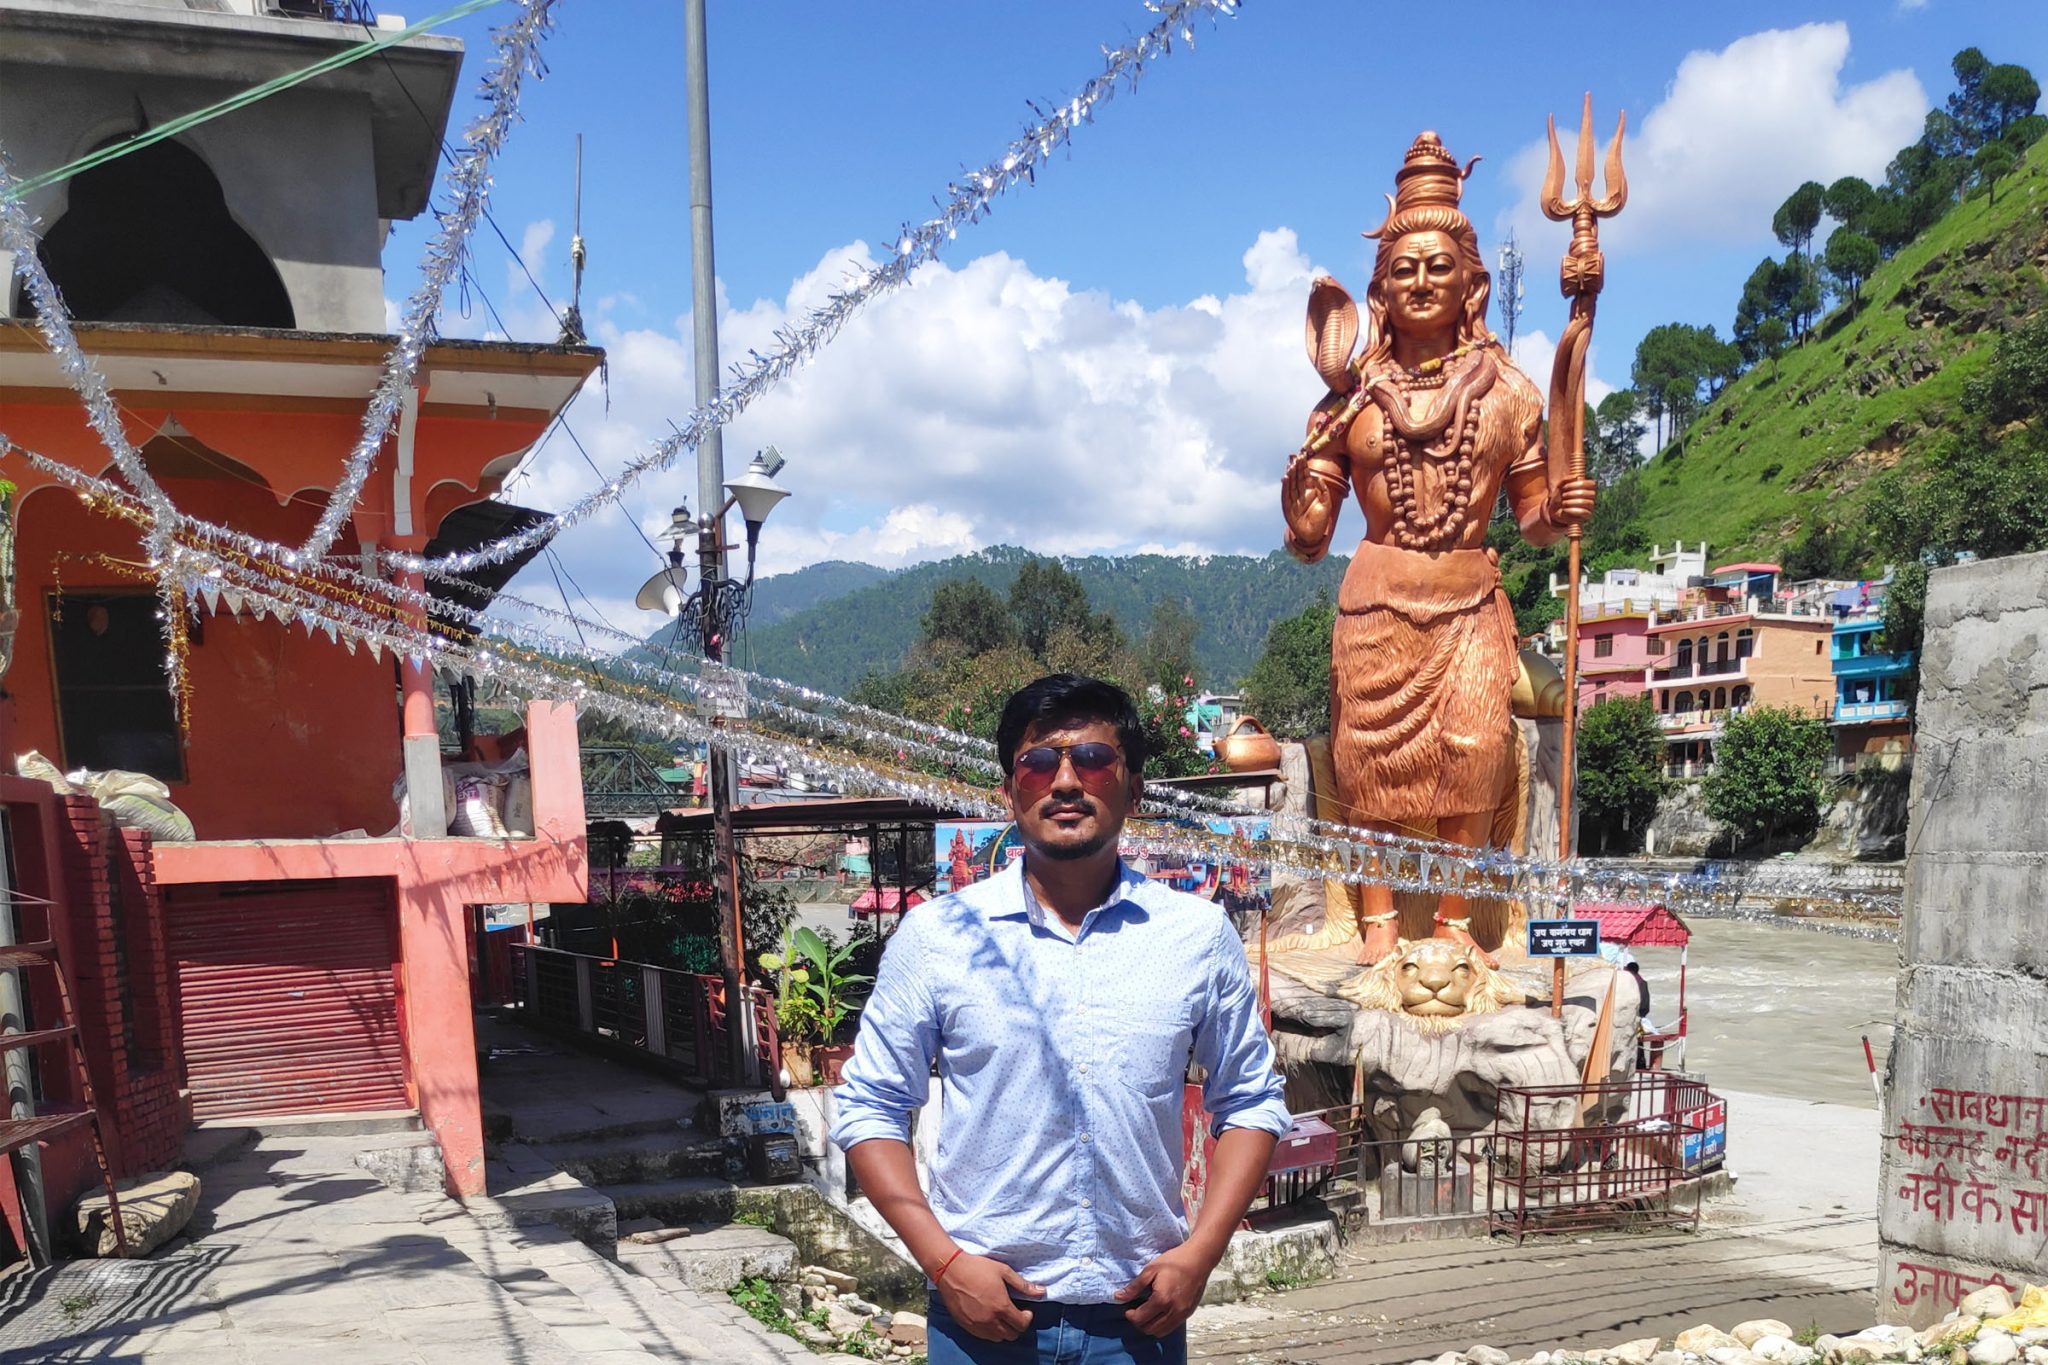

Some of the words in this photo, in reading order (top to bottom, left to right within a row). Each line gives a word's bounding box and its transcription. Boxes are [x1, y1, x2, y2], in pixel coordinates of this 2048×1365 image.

[1533, 928, 1546, 937] जय
[1541, 939, 1553, 948] जय
[1899, 1161, 1962, 1222] नदी
[1961, 1169, 2002, 1224] के
